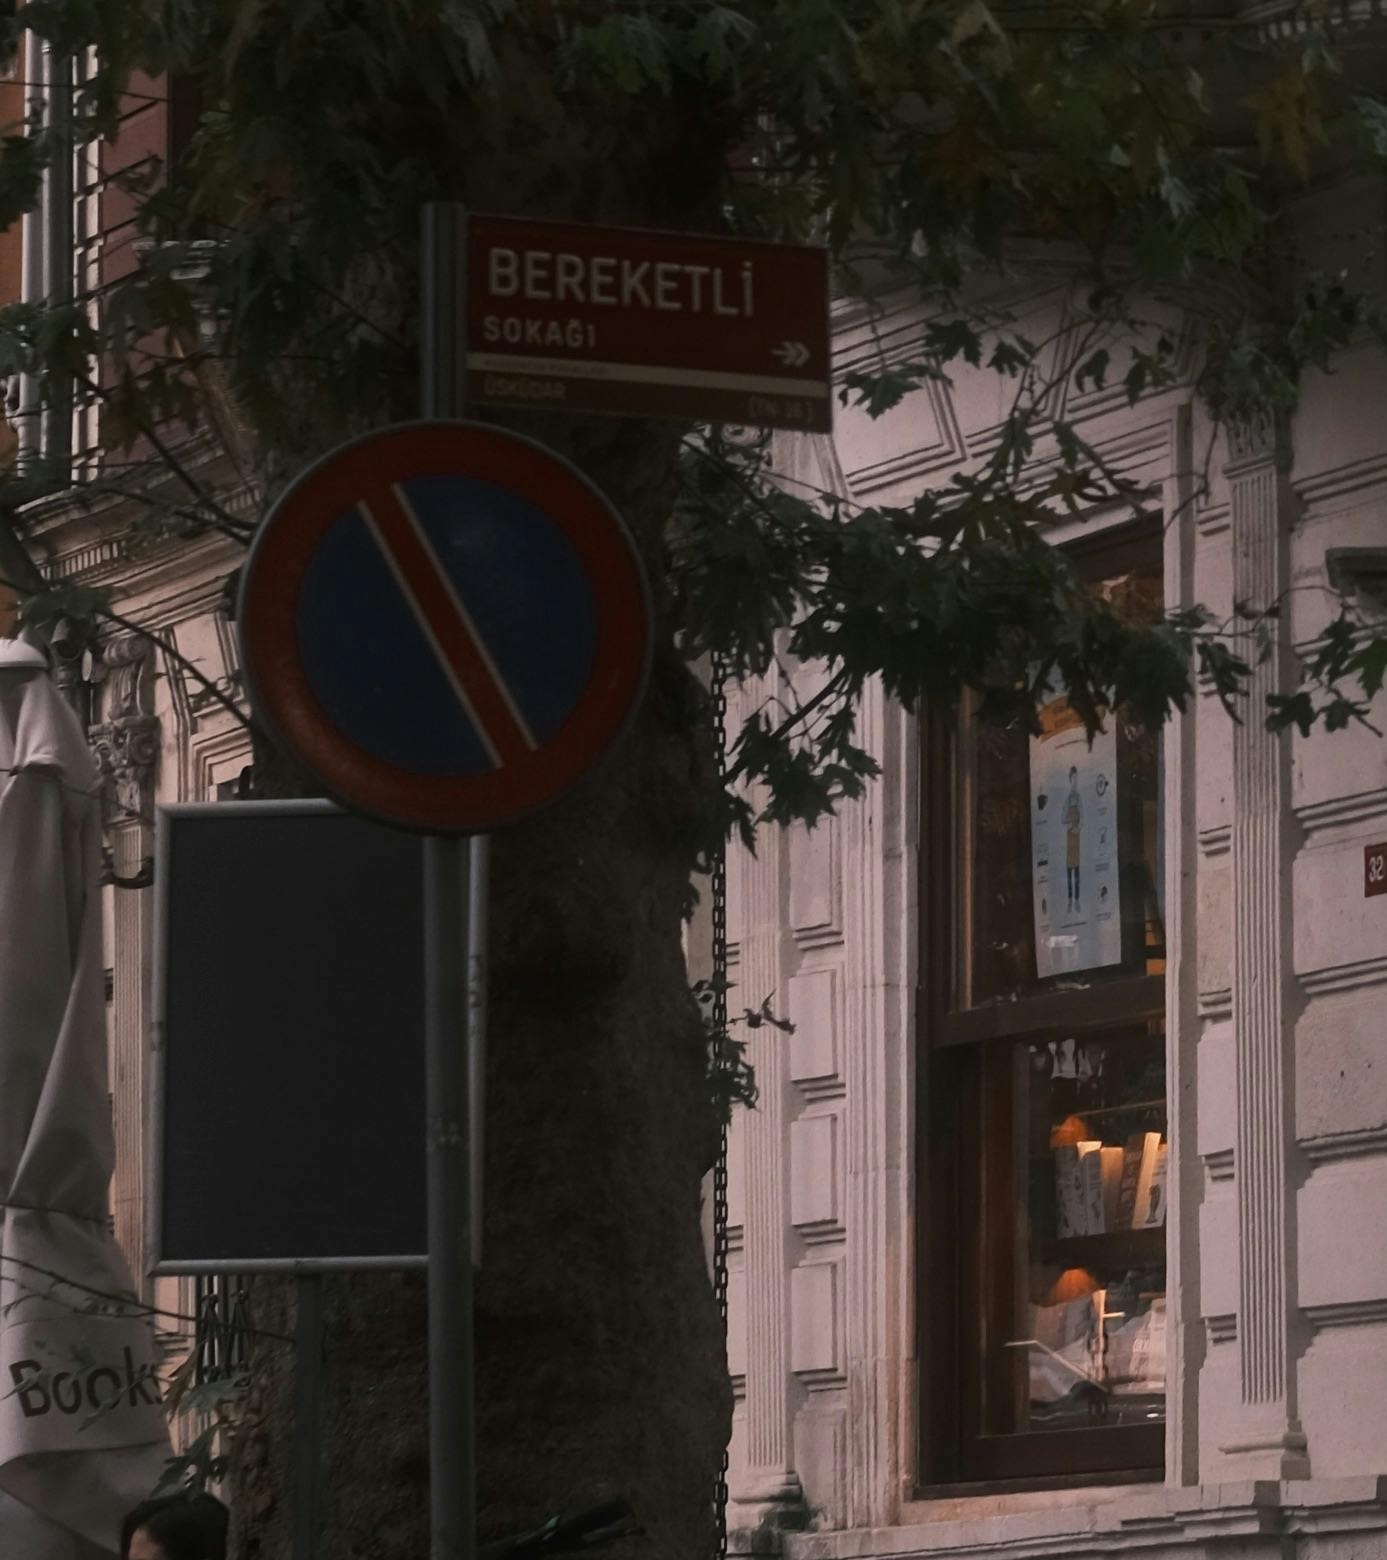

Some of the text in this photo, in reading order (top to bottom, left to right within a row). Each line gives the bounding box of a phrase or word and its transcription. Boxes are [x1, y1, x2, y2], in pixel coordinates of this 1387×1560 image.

[488, 247, 755, 317] BEREKETLİ
[483, 315, 596, 349] SOKAĞI
[1368, 855, 1384, 883] 32
